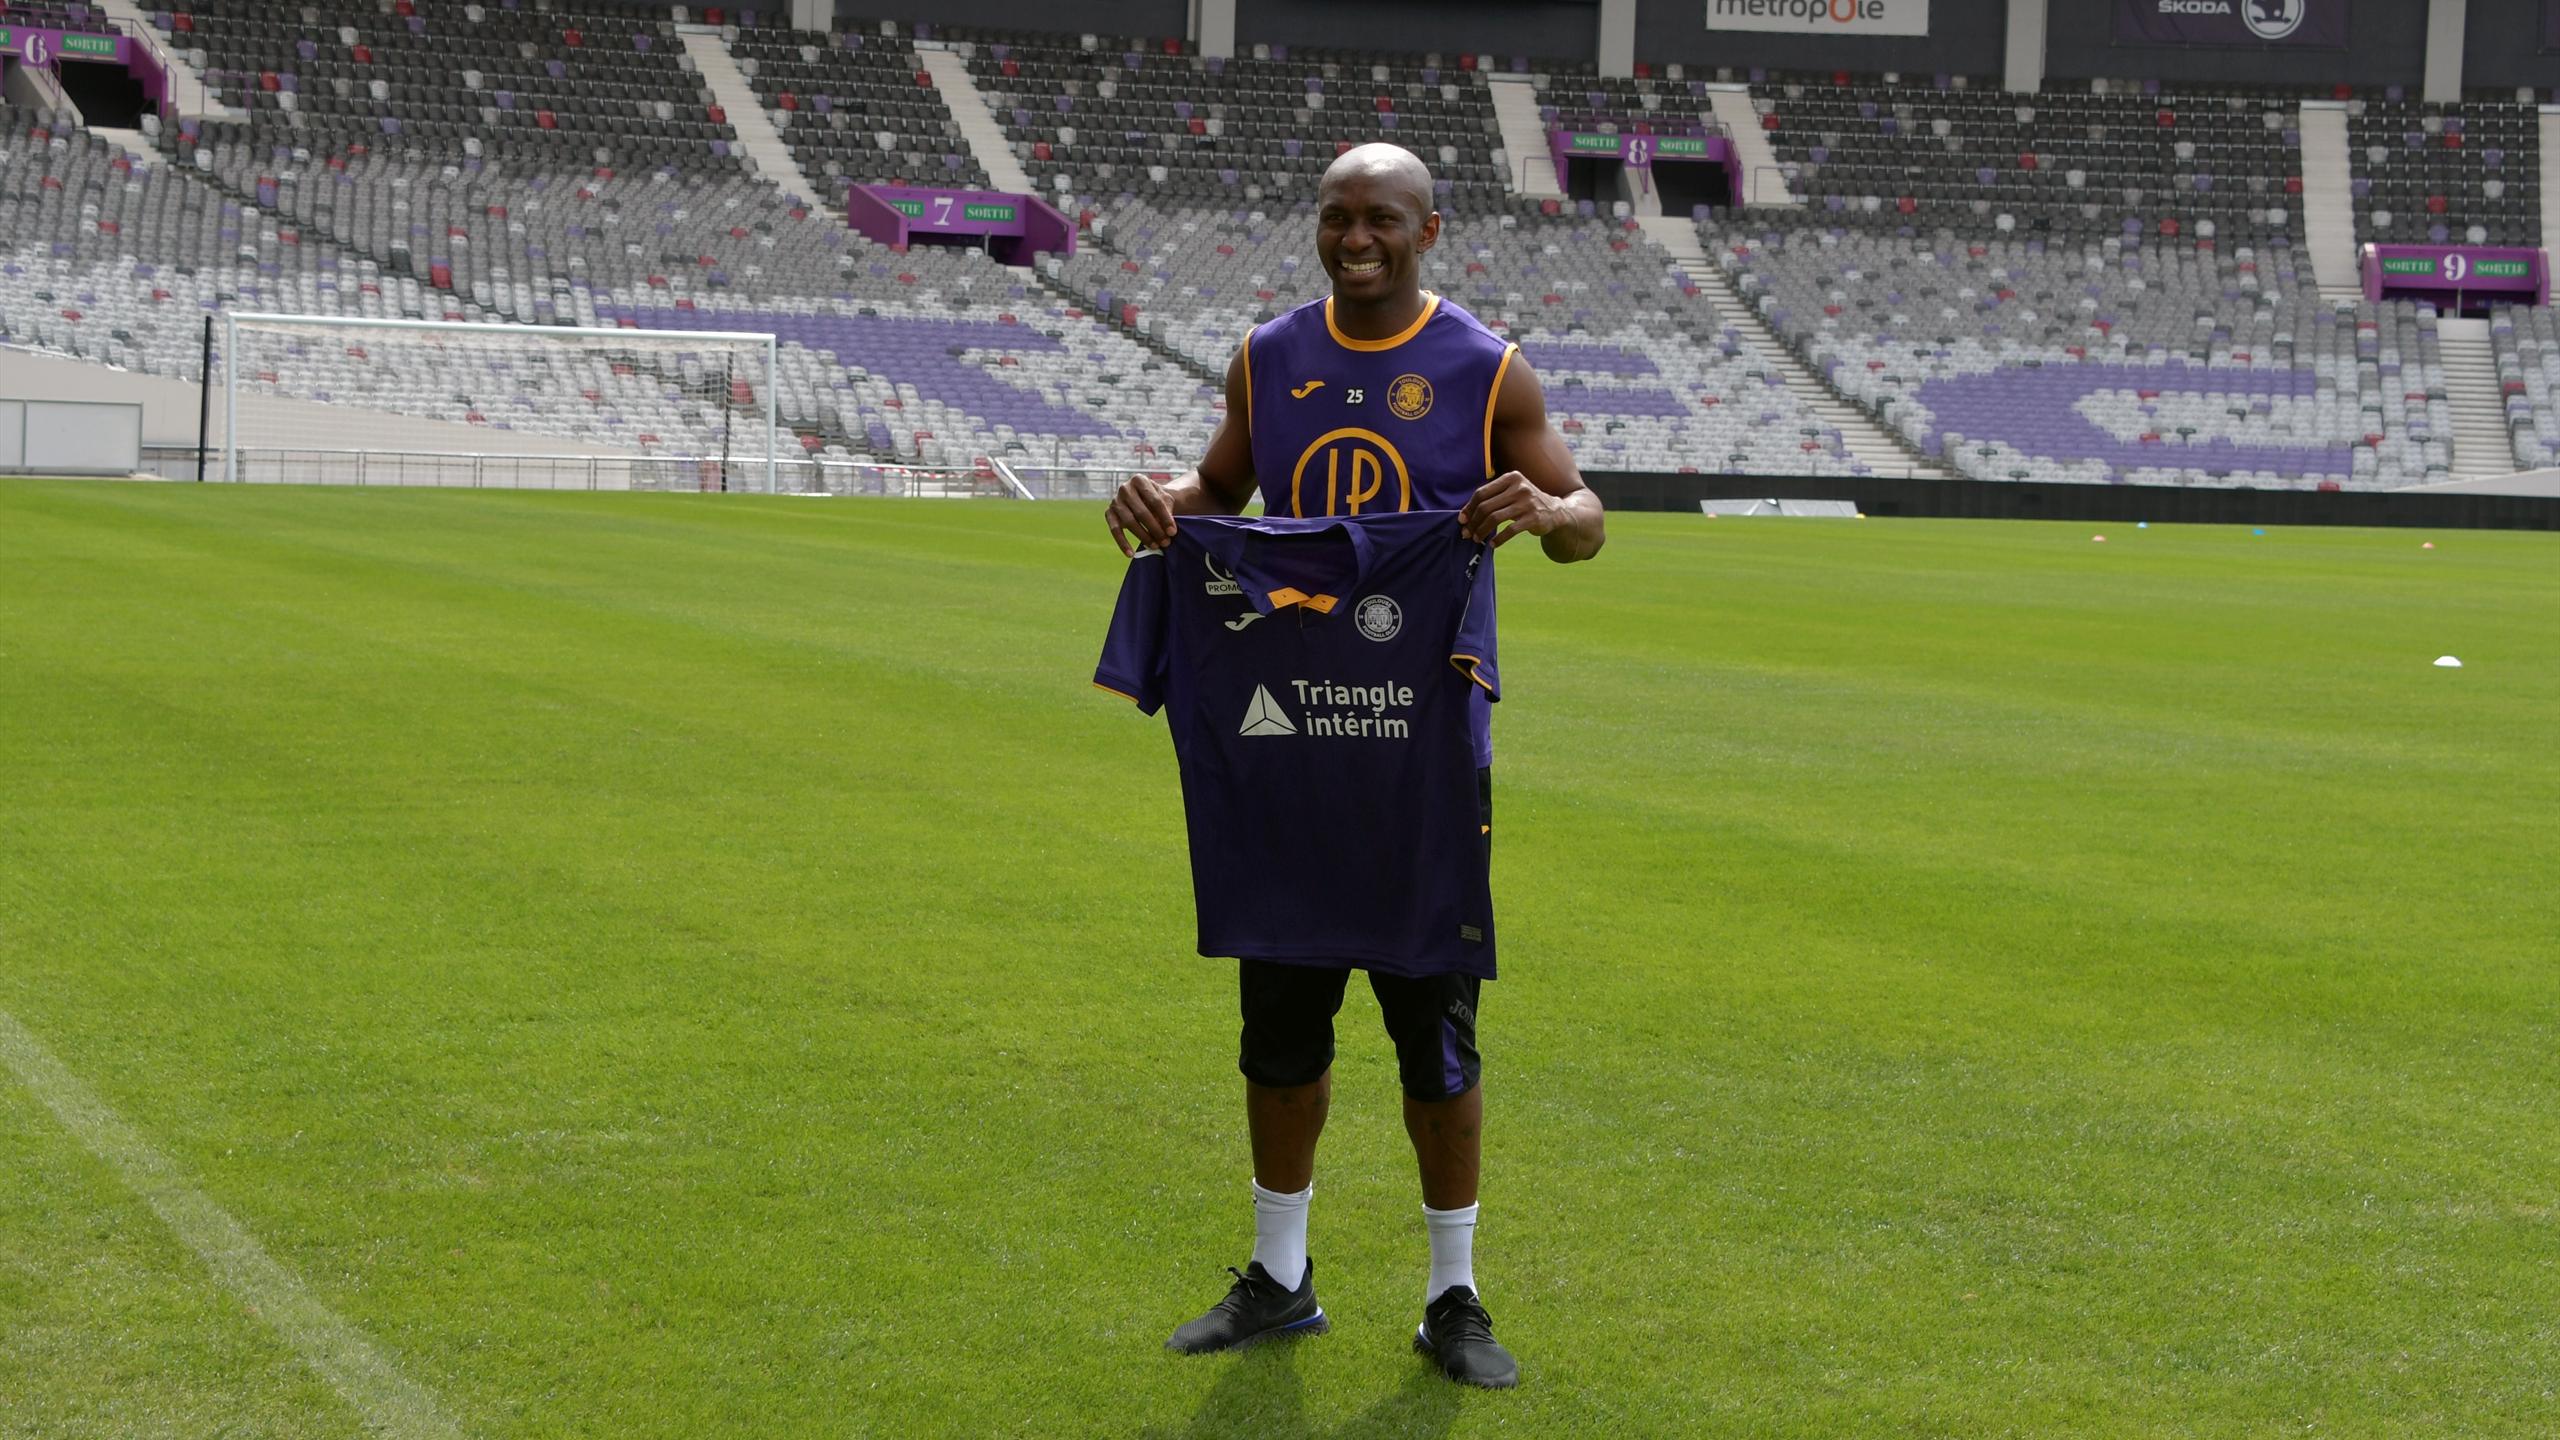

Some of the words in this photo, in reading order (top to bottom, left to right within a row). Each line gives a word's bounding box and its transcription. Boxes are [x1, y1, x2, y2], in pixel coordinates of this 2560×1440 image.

[25, 32, 48, 64] 6
[65, 37, 114, 52] SORTIE
[1574, 136, 1620, 149] SORTIE
[1628, 138, 1648, 164] 8
[1660, 139, 1704, 152] SORTIE
[933, 196, 955, 227] 7
[967, 206, 1014, 220] SORTIE
[2384, 259, 2433, 273] SORTIE
[2443, 253, 2467, 281] 9
[2477, 261, 2527, 275] SORTIE
[1346, 389, 1364, 404] 25
[1291, 679, 1414, 712] Triangle
[1305, 711, 1409, 739] intérim
